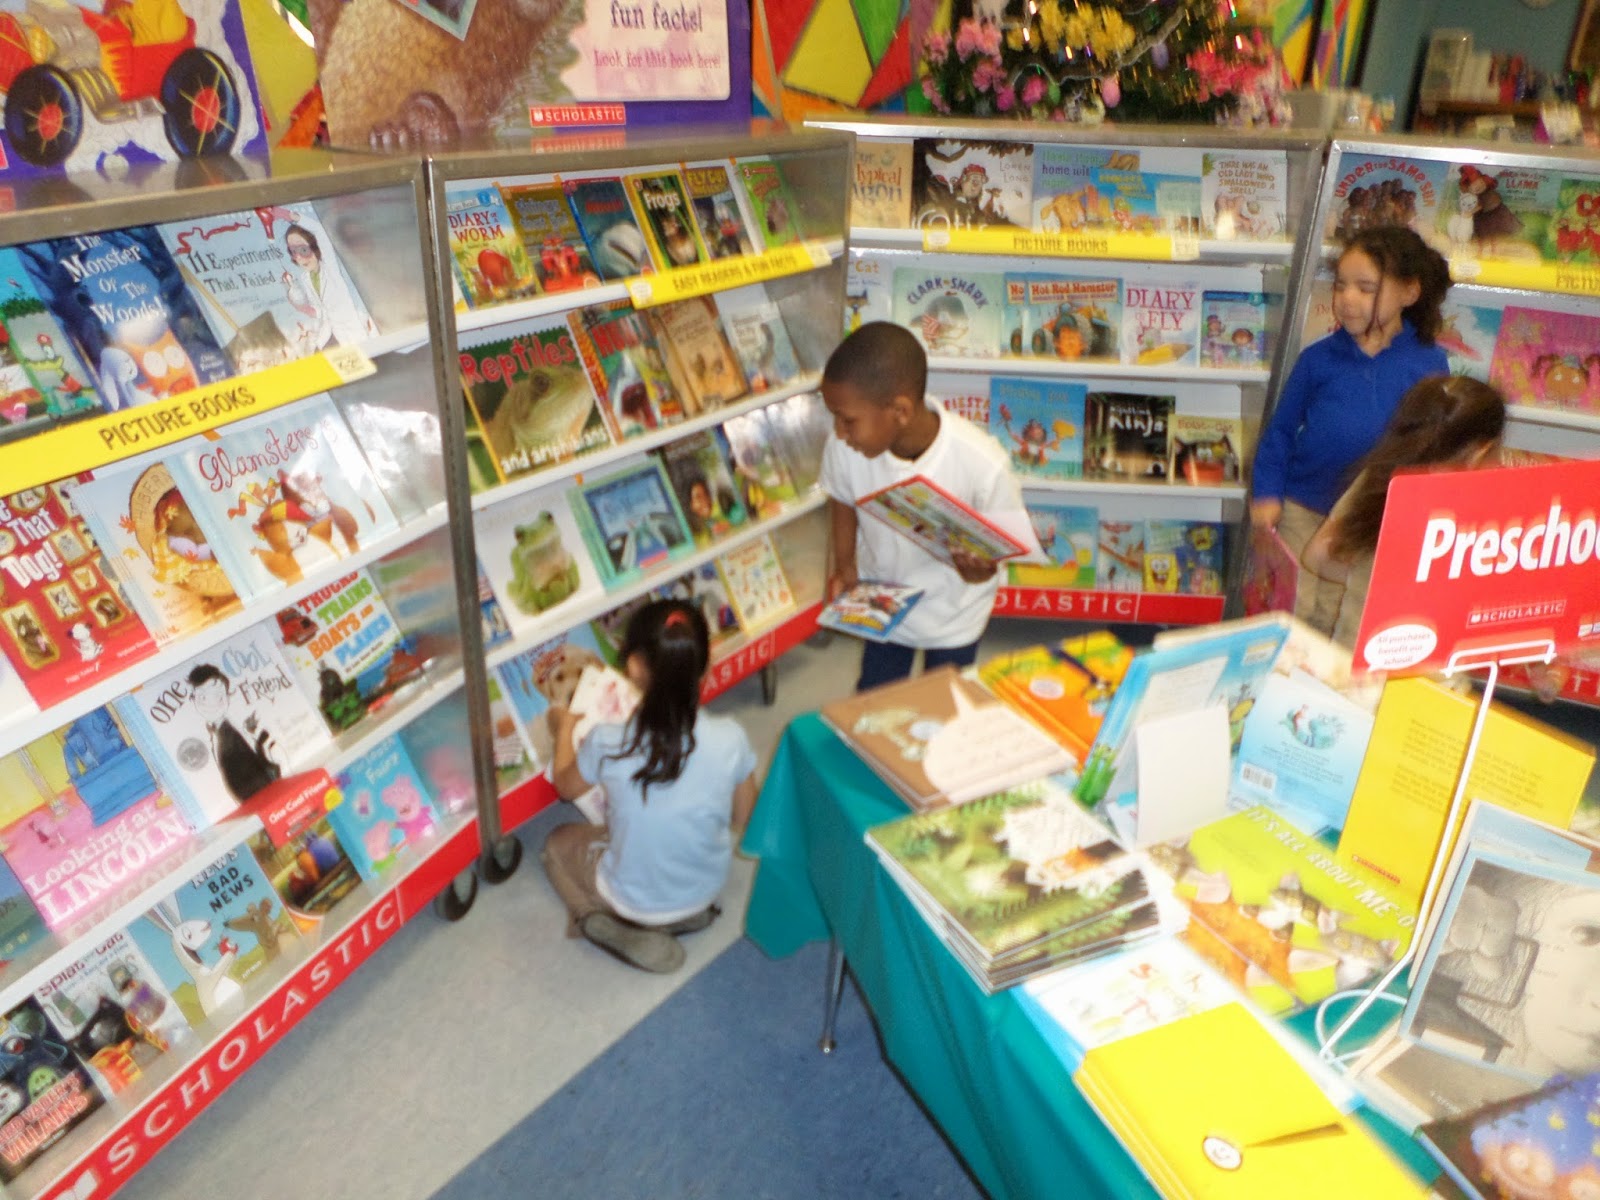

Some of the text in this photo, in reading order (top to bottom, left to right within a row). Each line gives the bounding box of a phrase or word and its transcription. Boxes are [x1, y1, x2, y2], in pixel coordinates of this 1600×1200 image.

[611, 0, 702, 31] fun facts!
[594, 49, 624, 67] Look
[627, 52, 643, 67] for
[646, 52, 667, 68] this
[670, 51, 693, 68] book
[545, 107, 623, 121] SCHOLASTIC
[1042, 164, 1090, 177] home wit
[643, 190, 681, 212] Frogs
[448, 211, 490, 228] DIARY
[454, 225, 505, 244] WORM
[1013, 234, 1108, 252] PICTURE BOOKS
[60, 244, 141, 283] Monster
[187, 244, 285, 274] 11 Experiments
[855, 259, 879, 273] Cat
[121, 281, 149, 299] The
[204, 270, 276, 295] That Failed
[907, 276, 989, 309] CLARK SHARK
[90, 298, 168, 325] Woods!
[1126, 288, 1195, 310] DIARY
[1148, 310, 1184, 331] FLY
[460, 335, 576, 388] Reptiles
[98, 385, 256, 451] PICTURE BOOKS
[199, 424, 319, 492] Glamsters
[500, 448, 531, 474] and
[7, 507, 58, 546] That
[1415, 505, 1600, 583] Prescho
[1, 541, 63, 589] Dog!
[317, 577, 373, 625] TRAINS
[993, 592, 1133, 615] OLASTIC
[1481, 603, 1563, 622] SCHOLASTIC
[307, 612, 361, 660] BOATS
[702, 640, 769, 697] ASTIC
[269, 809, 286, 824] One
[286, 794, 304, 812] Cool
[304, 777, 328, 798] Friend
[25, 822, 132, 894] Looking
[37, 810, 192, 925] LINCOLN
[1307, 852, 1365, 889] ABOUT
[207, 867, 240, 895] BAD
[209, 874, 254, 914] NEWS
[107, 903, 396, 1175] SCHOLASTIC
[0, 1094, 88, 1163] VILLAINS
